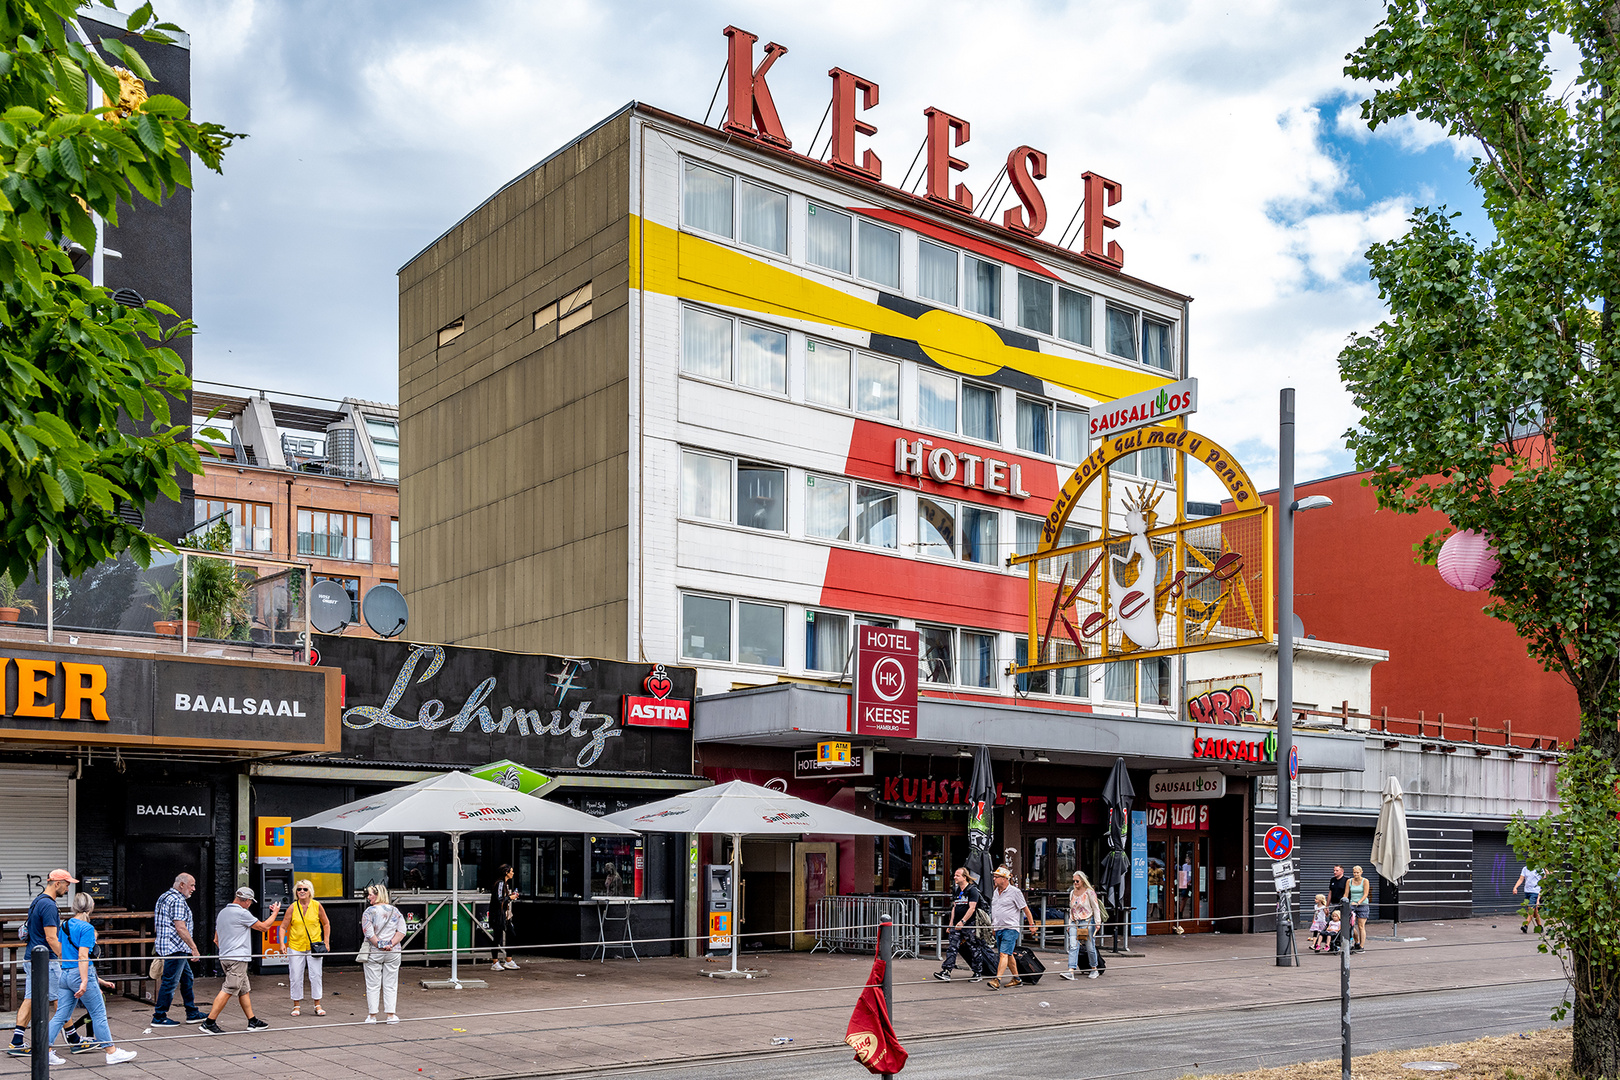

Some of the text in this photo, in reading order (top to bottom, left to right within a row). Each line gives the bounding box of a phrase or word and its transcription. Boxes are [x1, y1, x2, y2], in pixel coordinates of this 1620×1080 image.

[723, 25, 1124, 270] KEESE
[895, 438, 1031, 500] HOTEL
[1147, 430, 1188, 447] mal
[1189, 438, 1202, 454] y
[1205, 448, 1249, 503] pense
[867, 631, 912, 651] HOTEL
[879, 671, 898, 686] HK
[0, 656, 111, 721] ER
[175, 693, 307, 718] BAALSAAL
[342, 645, 623, 768] Lehmitz
[630, 704, 687, 720] ASTRA
[865, 706, 910, 725] KEESE
[876, 724, 900, 732] HAMBURG
[136, 804, 206, 816] BAALSAAL
[1028, 803, 1047, 821] WE
[711, 934, 731, 943] Cash
